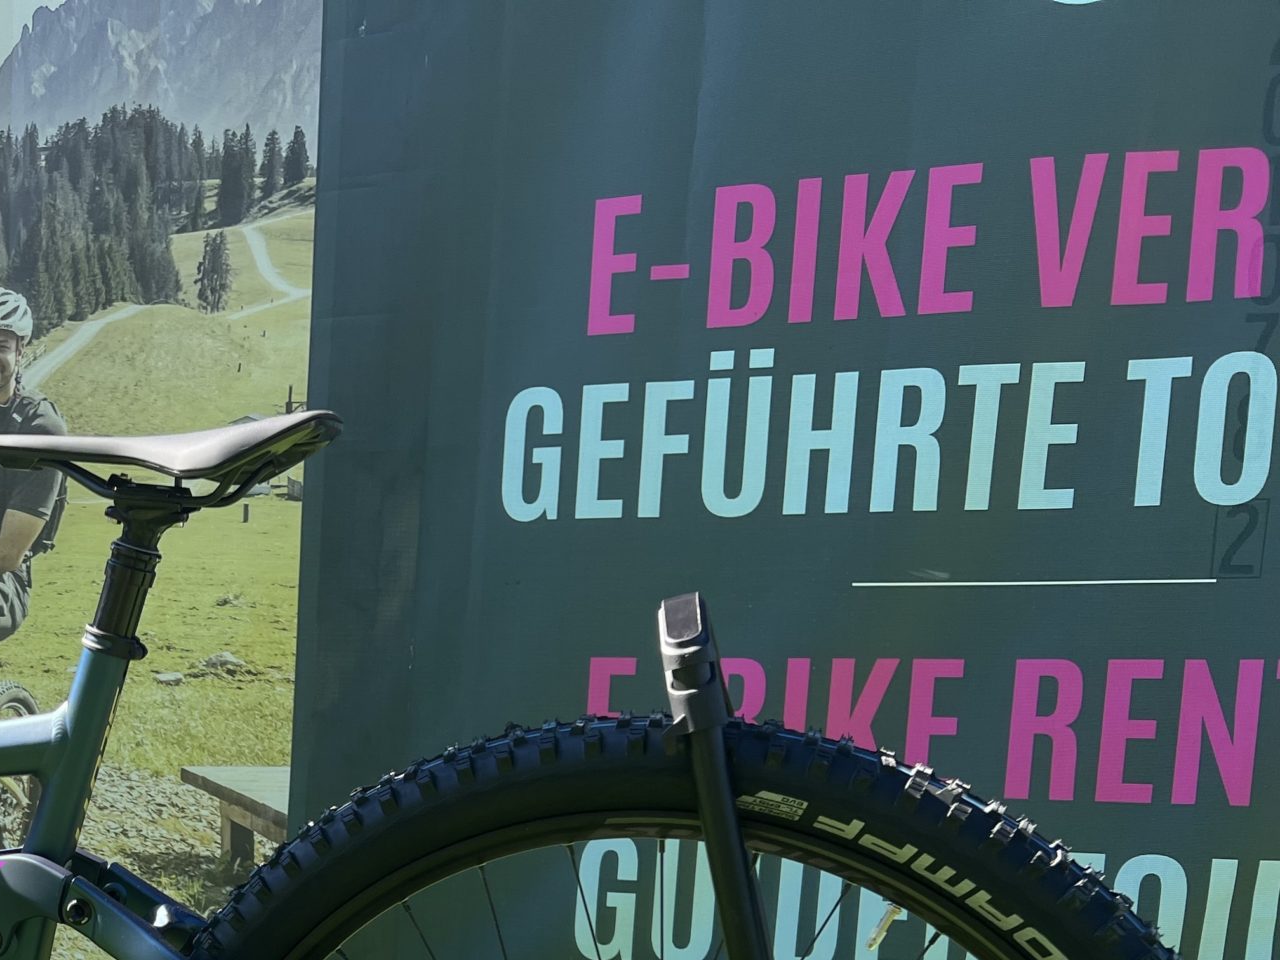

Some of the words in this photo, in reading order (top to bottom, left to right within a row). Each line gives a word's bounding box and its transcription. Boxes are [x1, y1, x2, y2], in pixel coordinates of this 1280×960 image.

[587, 163, 984, 336] E-BIKE
[1030, 147, 1271, 308] VER
[501, 348, 1086, 522] GEFÜHRTE
[1127, 351, 1278, 506] TO
[1003, 658, 1280, 806] REN
